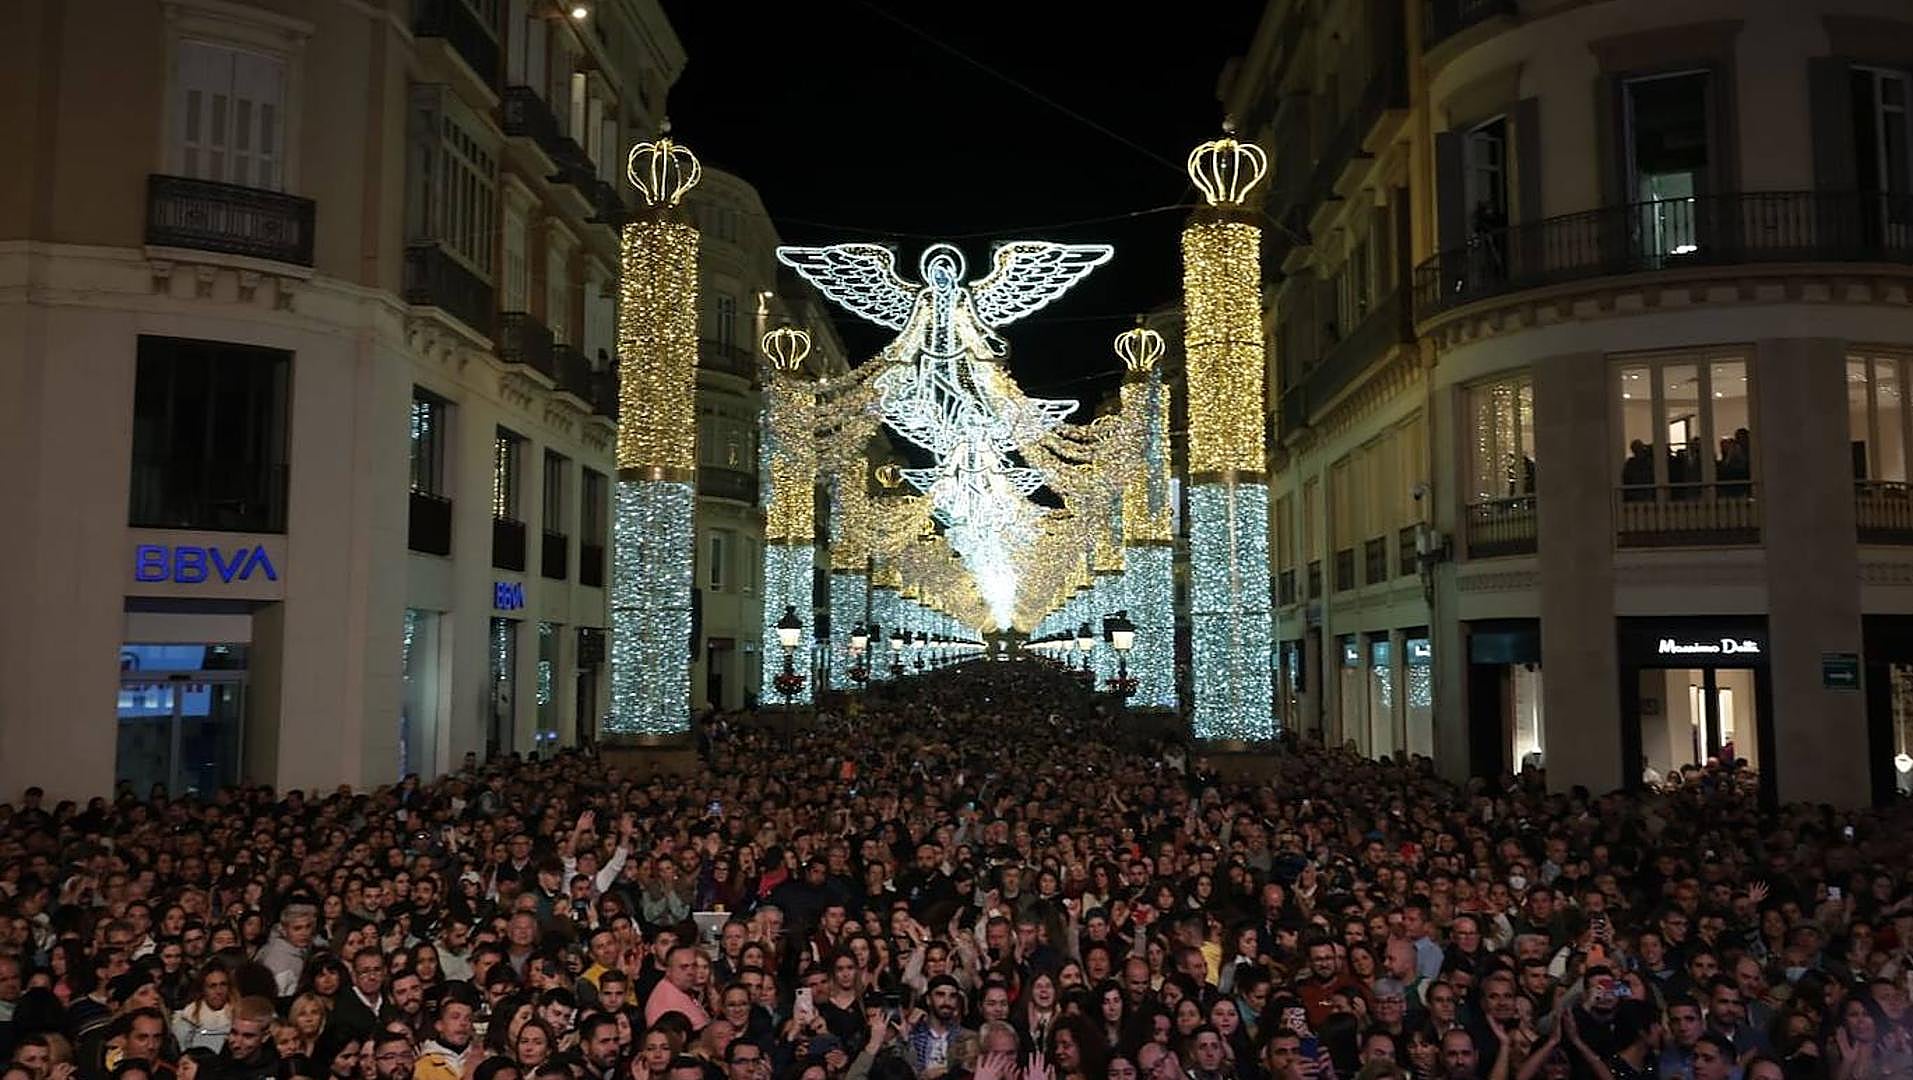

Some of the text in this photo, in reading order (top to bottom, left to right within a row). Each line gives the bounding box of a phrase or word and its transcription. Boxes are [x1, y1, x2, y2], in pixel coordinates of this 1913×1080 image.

[135, 544, 277, 583] BBVA
[494, 582, 525, 610] BBVA
[1659, 639, 1720, 654] Massimo
